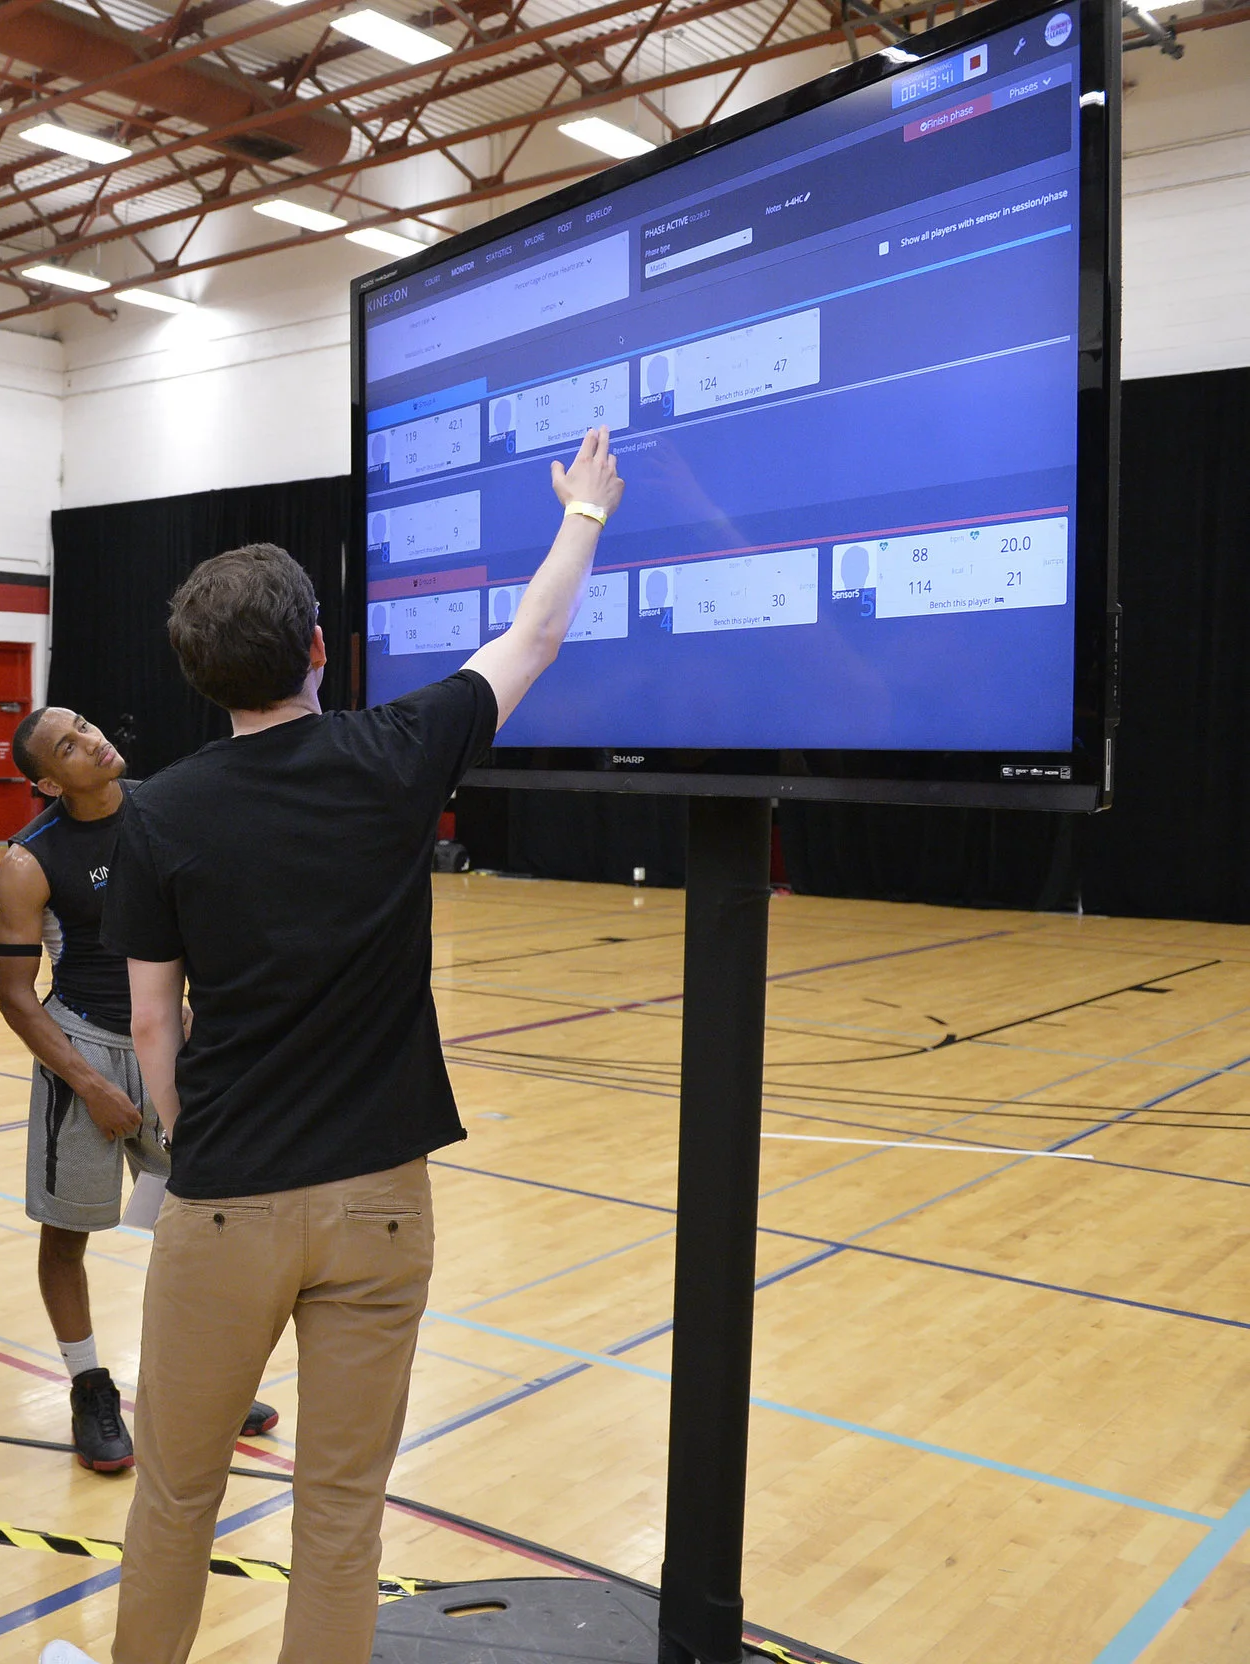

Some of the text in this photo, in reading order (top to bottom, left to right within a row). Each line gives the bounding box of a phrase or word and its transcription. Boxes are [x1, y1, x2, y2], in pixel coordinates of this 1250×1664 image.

[901, 70, 954, 102] 00:43:41
[1009, 81, 1038, 99] Phases
[927, 106, 974, 132] Finish phase
[585, 205, 613, 223] DEVELOP
[765, 204, 781, 215] Notes
[900, 189, 1068, 247] Show all players with sensor in session/phase
[557, 222, 573, 233] POST
[644, 224, 666, 239] PHASE
[666, 216, 689, 231] ACTIVE
[524, 232, 546, 247] XPLORE
[485, 246, 513, 264] STATISTICS
[645, 244, 671, 258] Phase type
[451, 261, 475, 277] MONITOR
[367, 287, 408, 312] KINEXON
[773, 359, 787, 372] 47
[588, 379, 608, 394] 35.7
[699, 377, 717, 391] 124
[715, 385, 763, 402] Bench this player
[535, 395, 549, 408] 110
[662, 393, 674, 416] 9
[593, 405, 604, 418] 30
[448, 418, 463, 430] 42.1
[535, 418, 549, 432] 125
[405, 431, 417, 443] 119
[506, 432, 515, 455] 6
[451, 441, 461, 453] 26
[613, 440, 658, 455] Benched players
[405, 452, 417, 464] 130
[453, 526, 459, 538] 9
[406, 535, 415, 546] 54
[1000, 536, 1031, 553] 20.0
[381, 544, 389, 563] 8
[912, 548, 928, 562] 88
[1006, 571, 1022, 586] 21
[589, 584, 607, 597] 50.7
[832, 589, 860, 600] Sensor5
[908, 580, 932, 595] 114
[448, 602, 464, 612] 40.0
[698, 601, 715, 614] 136
[772, 594, 785, 607] 30
[860, 591, 875, 617] 5
[929, 597, 991, 609] Bench this player
[405, 607, 417, 618] 116
[592, 611, 603, 623] 34
[639, 608, 661, 617] Sensor4
[660, 610, 672, 632] 4
[713, 614, 761, 626] Bench this player
[405, 629, 417, 640] 138
[451, 625, 460, 636] 42
[381, 635, 389, 655] 2
[612, 755, 644, 765] SHARP
